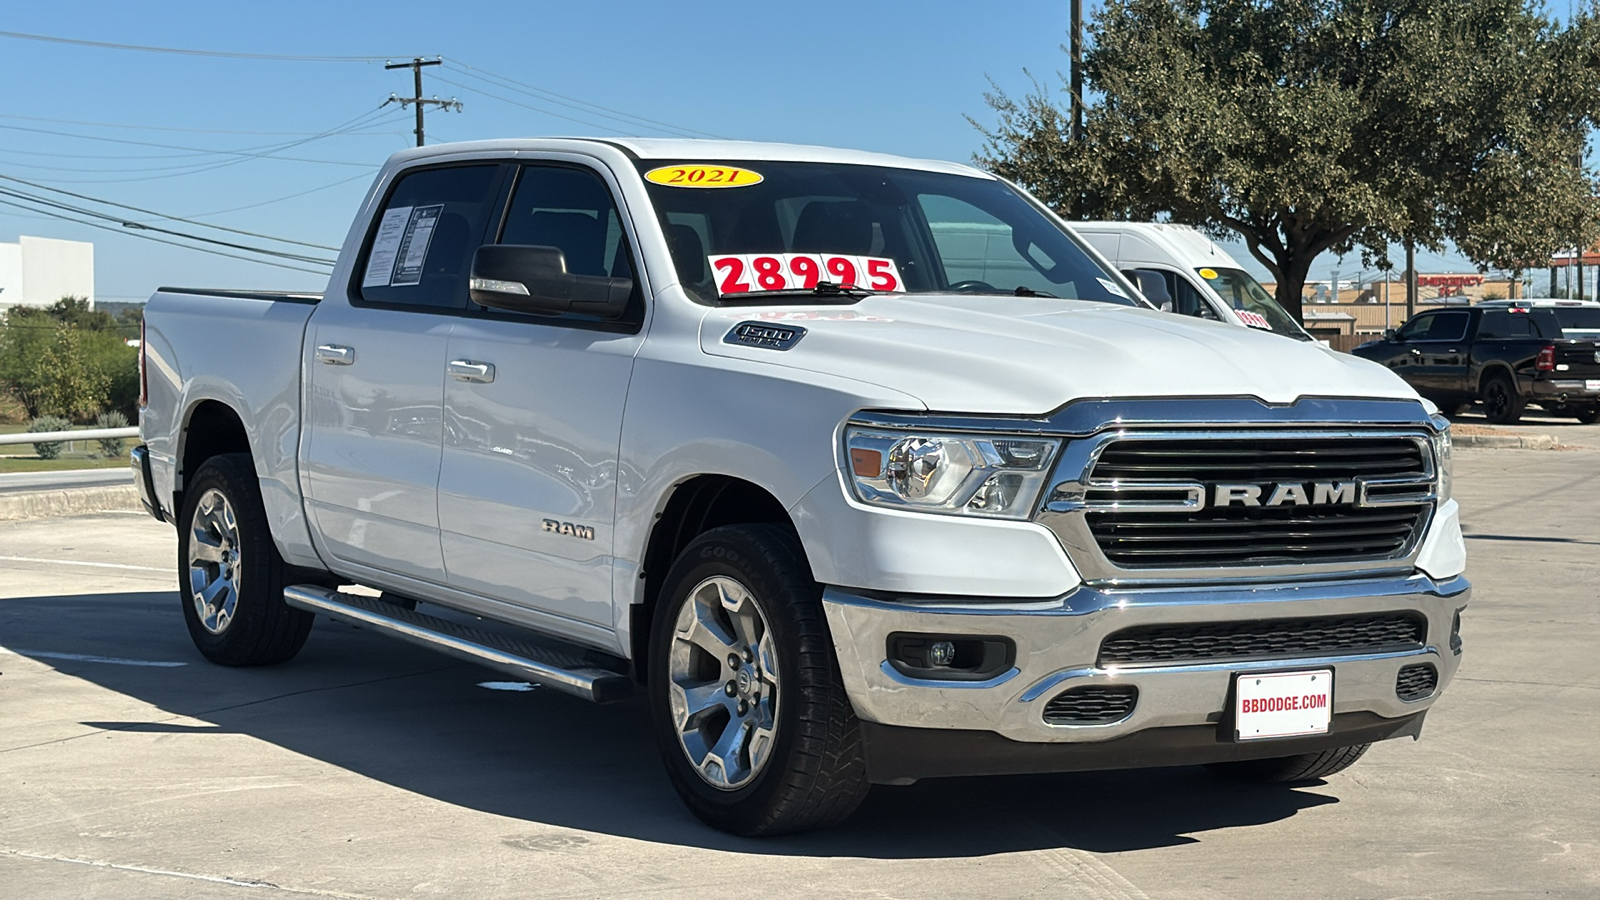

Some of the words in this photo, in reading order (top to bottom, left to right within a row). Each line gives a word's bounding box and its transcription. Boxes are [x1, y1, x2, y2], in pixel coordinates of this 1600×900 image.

[668, 169, 740, 183] 2021
[713, 256, 898, 294] 28995
[1417, 276, 1484, 287] EMERGENCY
[739, 325, 793, 340] 1500
[1214, 481, 1356, 507] RAM
[542, 518, 595, 541] RAM
[1242, 694, 1327, 713] BBDODGE.COM
